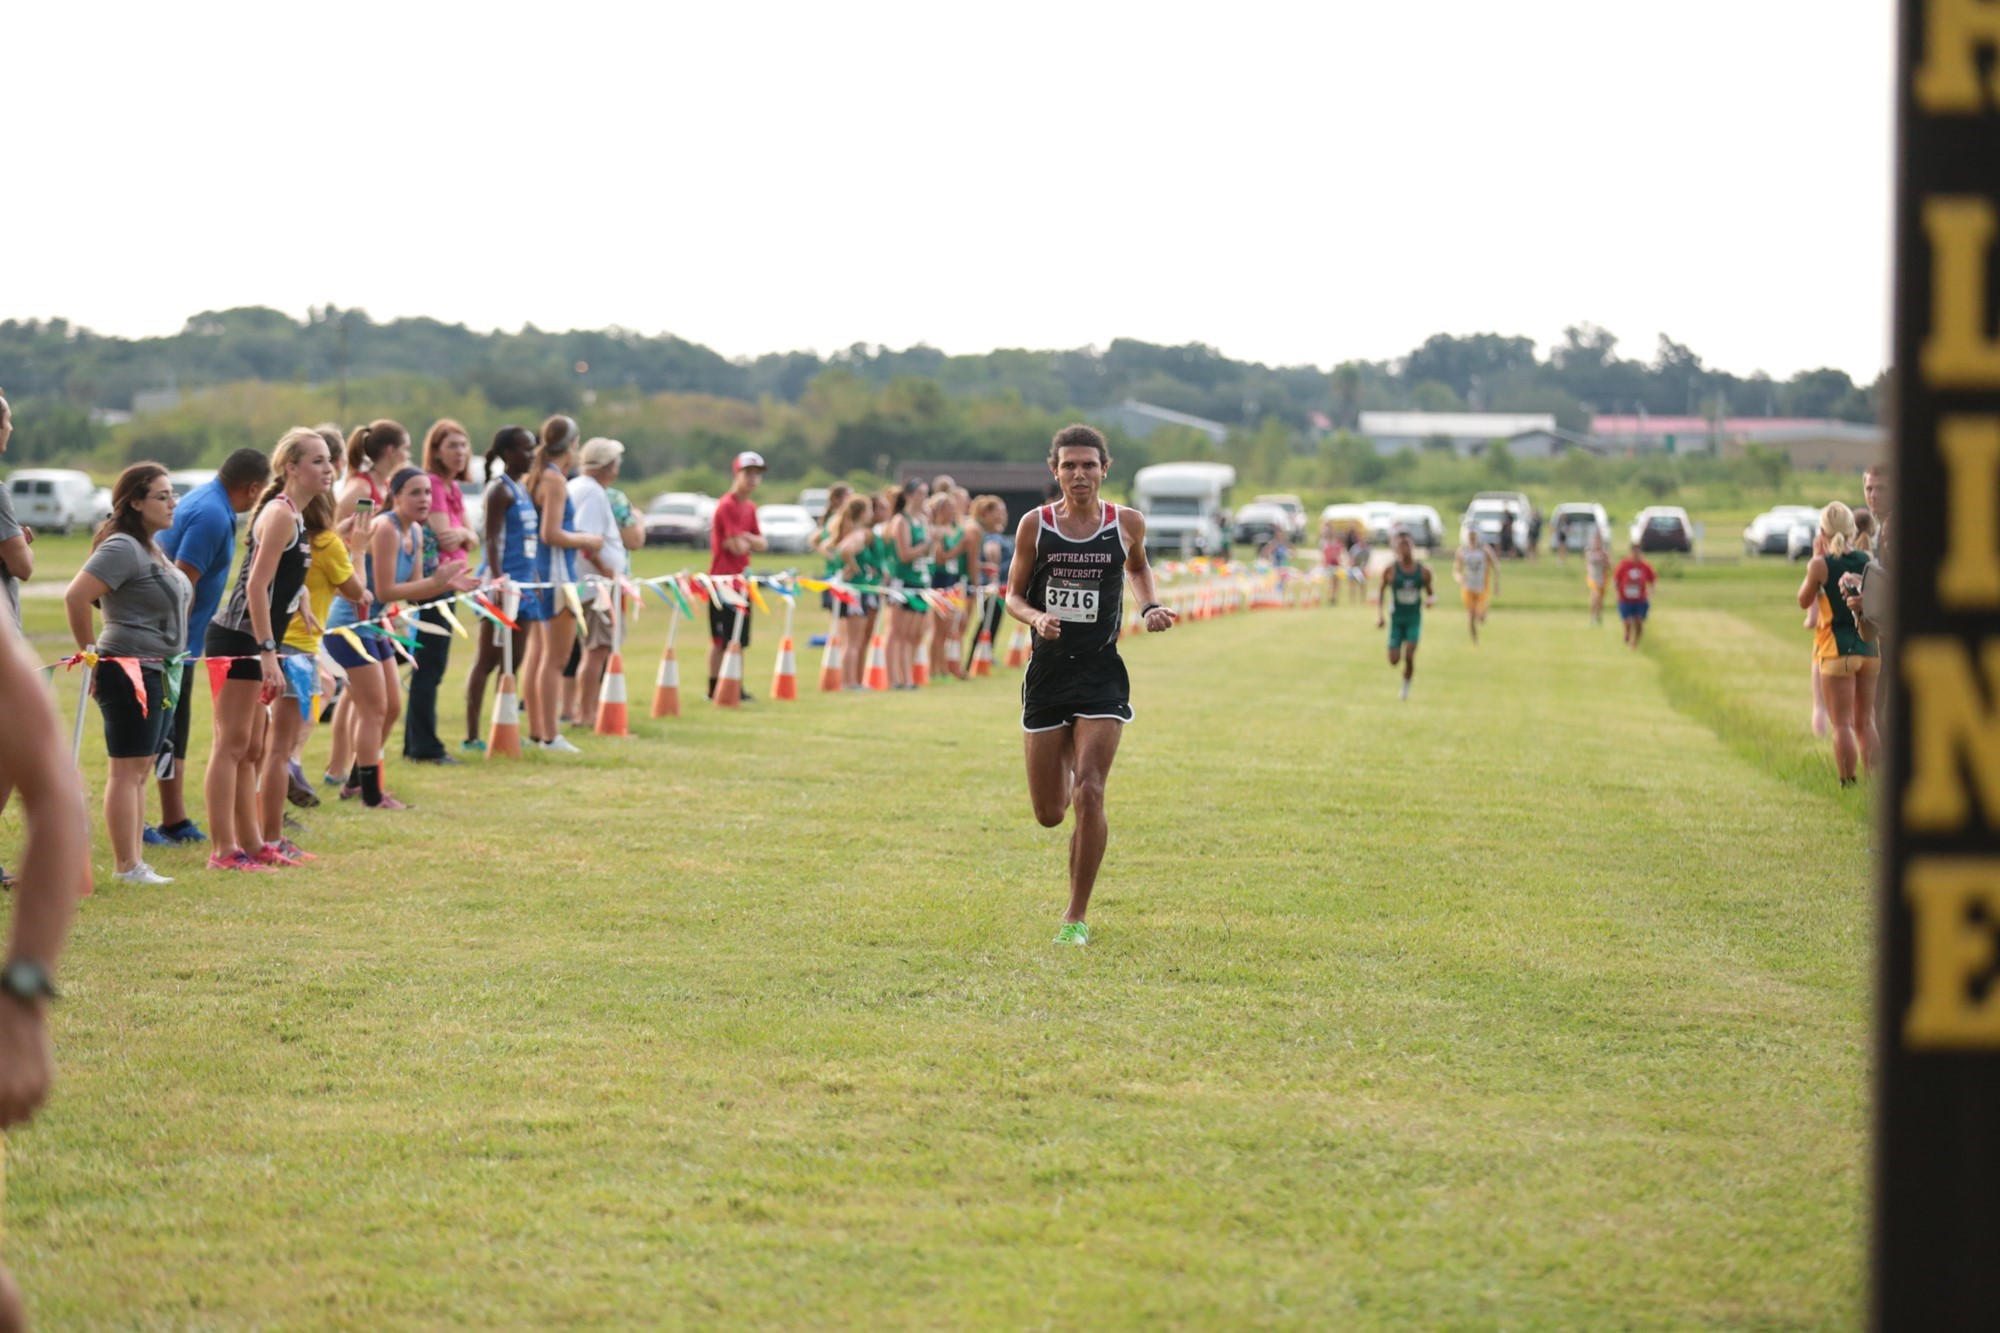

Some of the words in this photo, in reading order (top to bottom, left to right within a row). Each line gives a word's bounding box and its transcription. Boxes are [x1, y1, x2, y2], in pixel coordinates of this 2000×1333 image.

[1047, 552, 1112, 563] SOUTHEASTERN
[1053, 567, 1104, 579] UNIVERSITY
[1048, 588, 1094, 610] 3716
